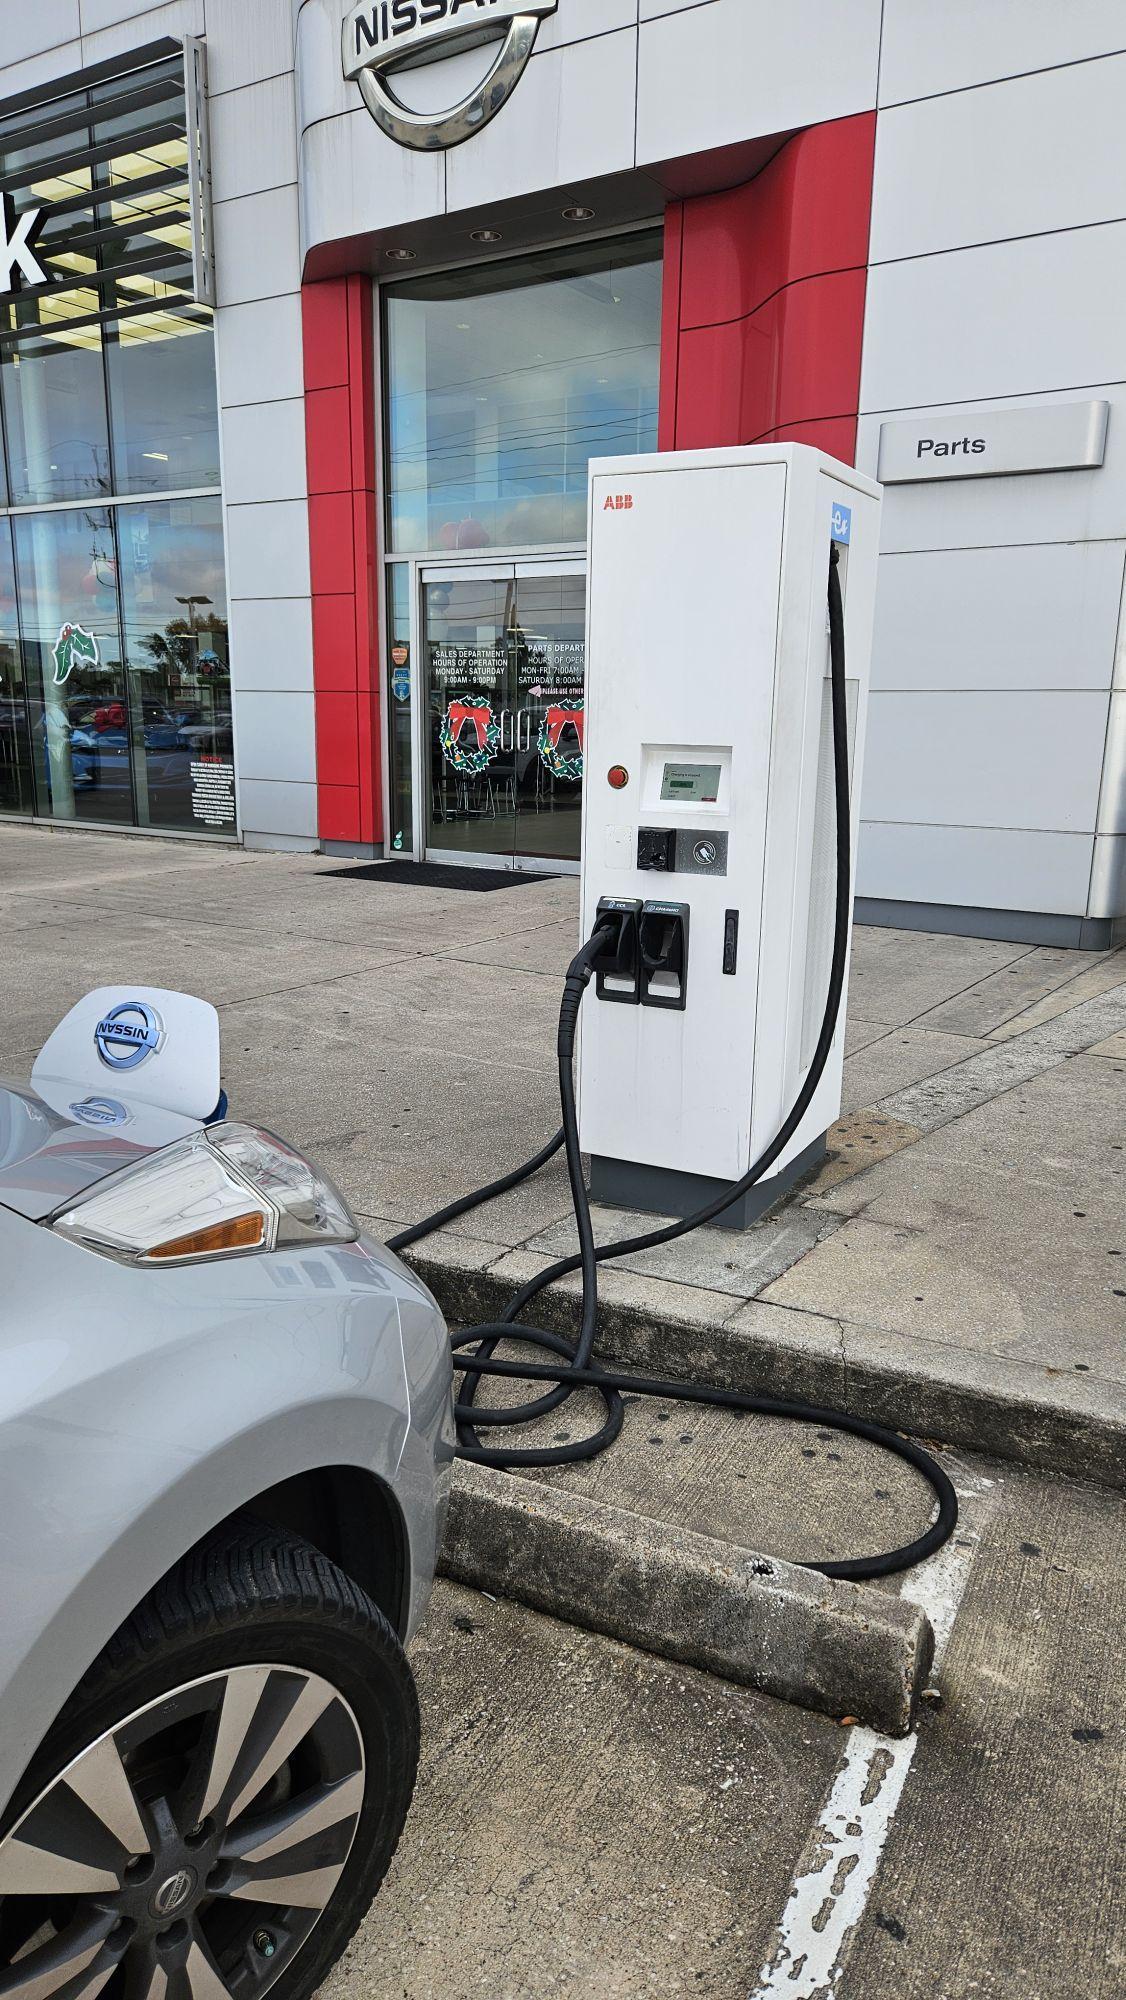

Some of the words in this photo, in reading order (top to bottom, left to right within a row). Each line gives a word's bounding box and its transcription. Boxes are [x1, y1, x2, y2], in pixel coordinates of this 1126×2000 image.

[354, 0, 499, 56] NISS
[916, 437, 987, 459] Parts
[603, 494, 634, 511] ABB
[528, 644, 553, 652] PARTS
[435, 650, 458, 658] SALES
[458, 650, 505, 658] DEPARTMENT
[432, 659, 456, 667] HOURS
[457, 659, 467, 667] OF
[468, 659, 508, 667] OPERATION
[528, 656, 552, 664] HOURS
[554, 656, 564, 664] OF
[435, 667, 464, 675] MONDAY
[468, 667, 505, 675] SATURDAY
[521, 666, 551, 674] MON-FRI
[553, 666, 579, 674] 7:00AM
[443, 676, 468, 684] 9:00AM
[472, 676, 497, 684] 9:00PM
[518, 676, 554, 684] SATURDAY
[555, 676, 582, 684] 8:00AM
[542, 687, 559, 695] PLEASE
[559, 687, 568, 695] USE
[98, 1022, 149, 1041] NISSAN
